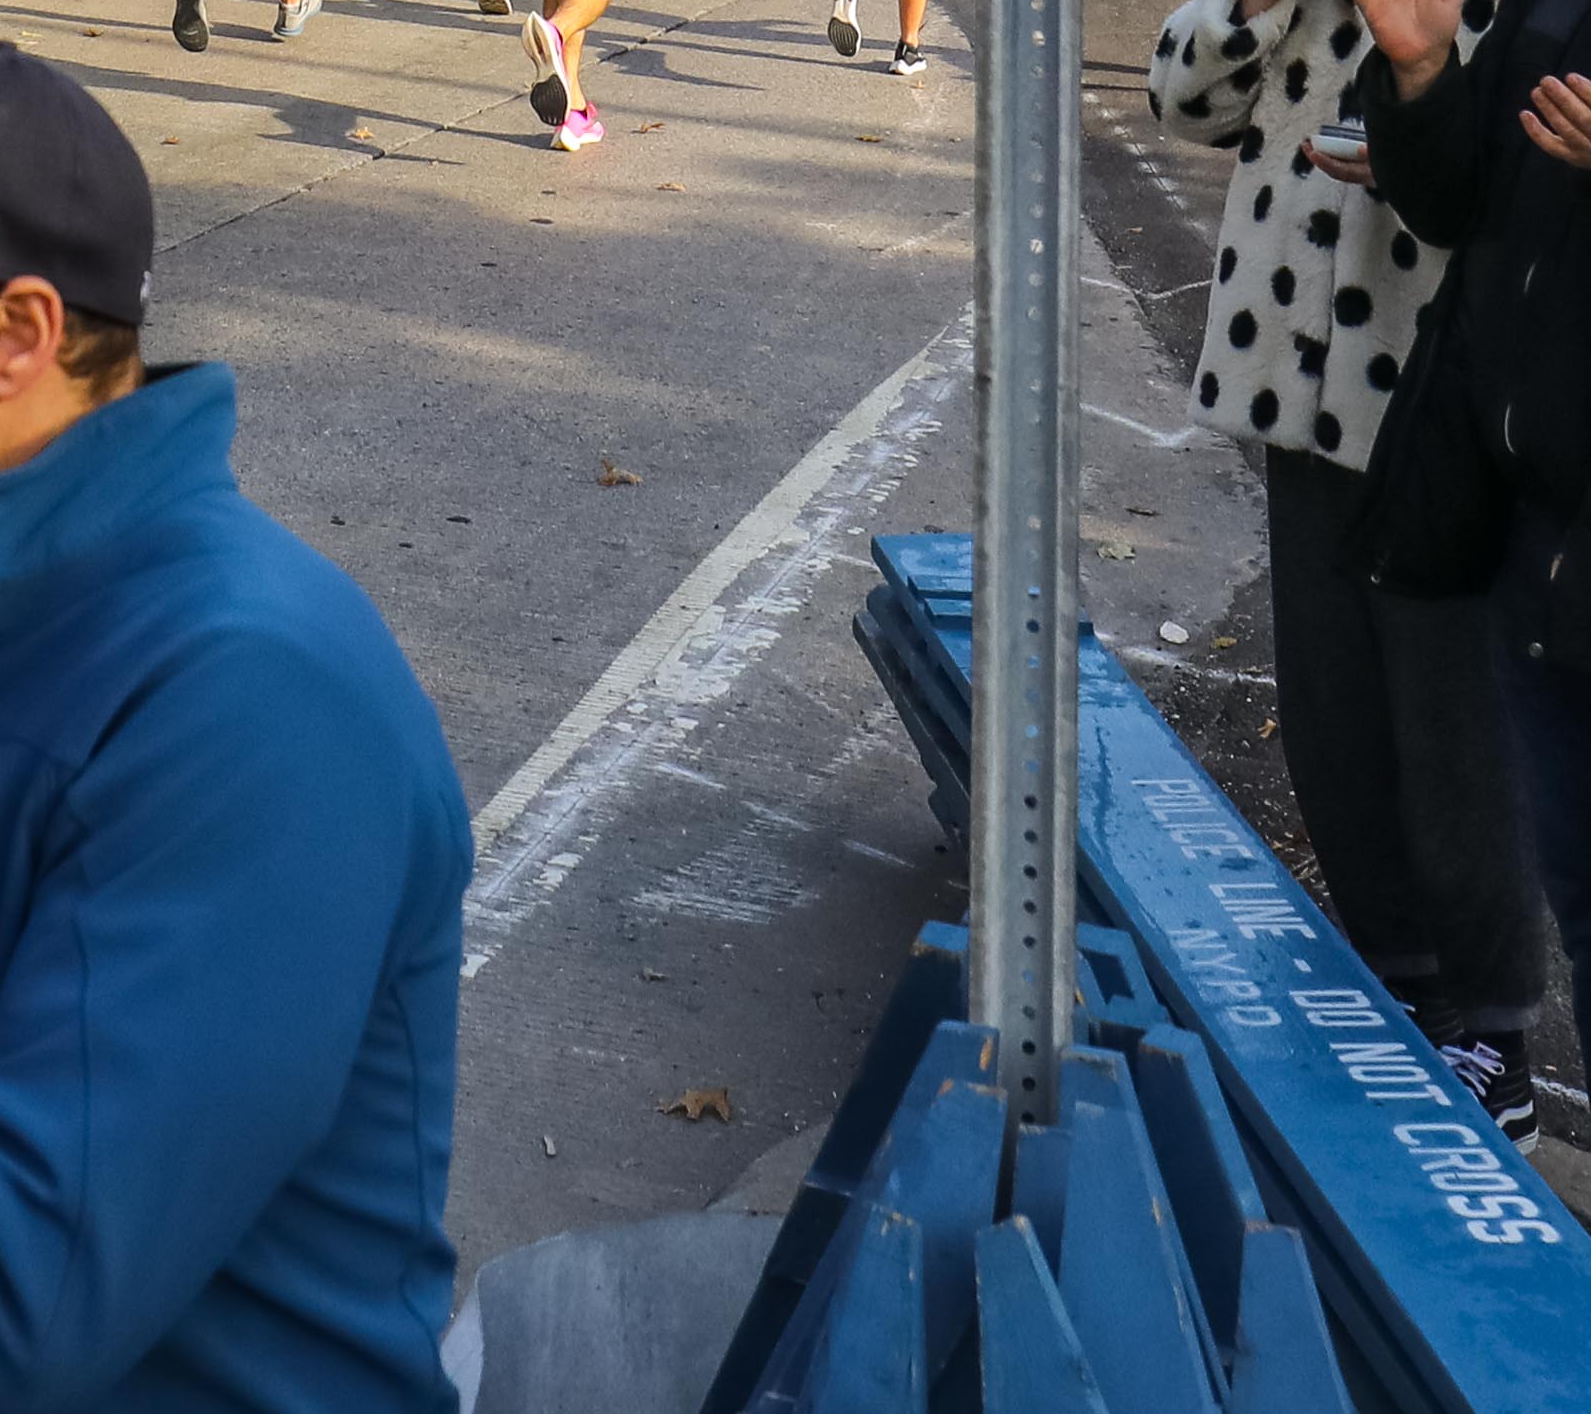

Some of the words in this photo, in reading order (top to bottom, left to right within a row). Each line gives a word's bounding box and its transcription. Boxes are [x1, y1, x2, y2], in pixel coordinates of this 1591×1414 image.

[1130, 779, 1254, 860] POLICE
[1208, 882, 1318, 940] LINE
[1168, 930, 1283, 1027] NYPD
[1289, 989, 1386, 1027] DO
[1328, 1041, 1452, 1107] NOT
[1392, 1122, 1562, 1245] CROSS
